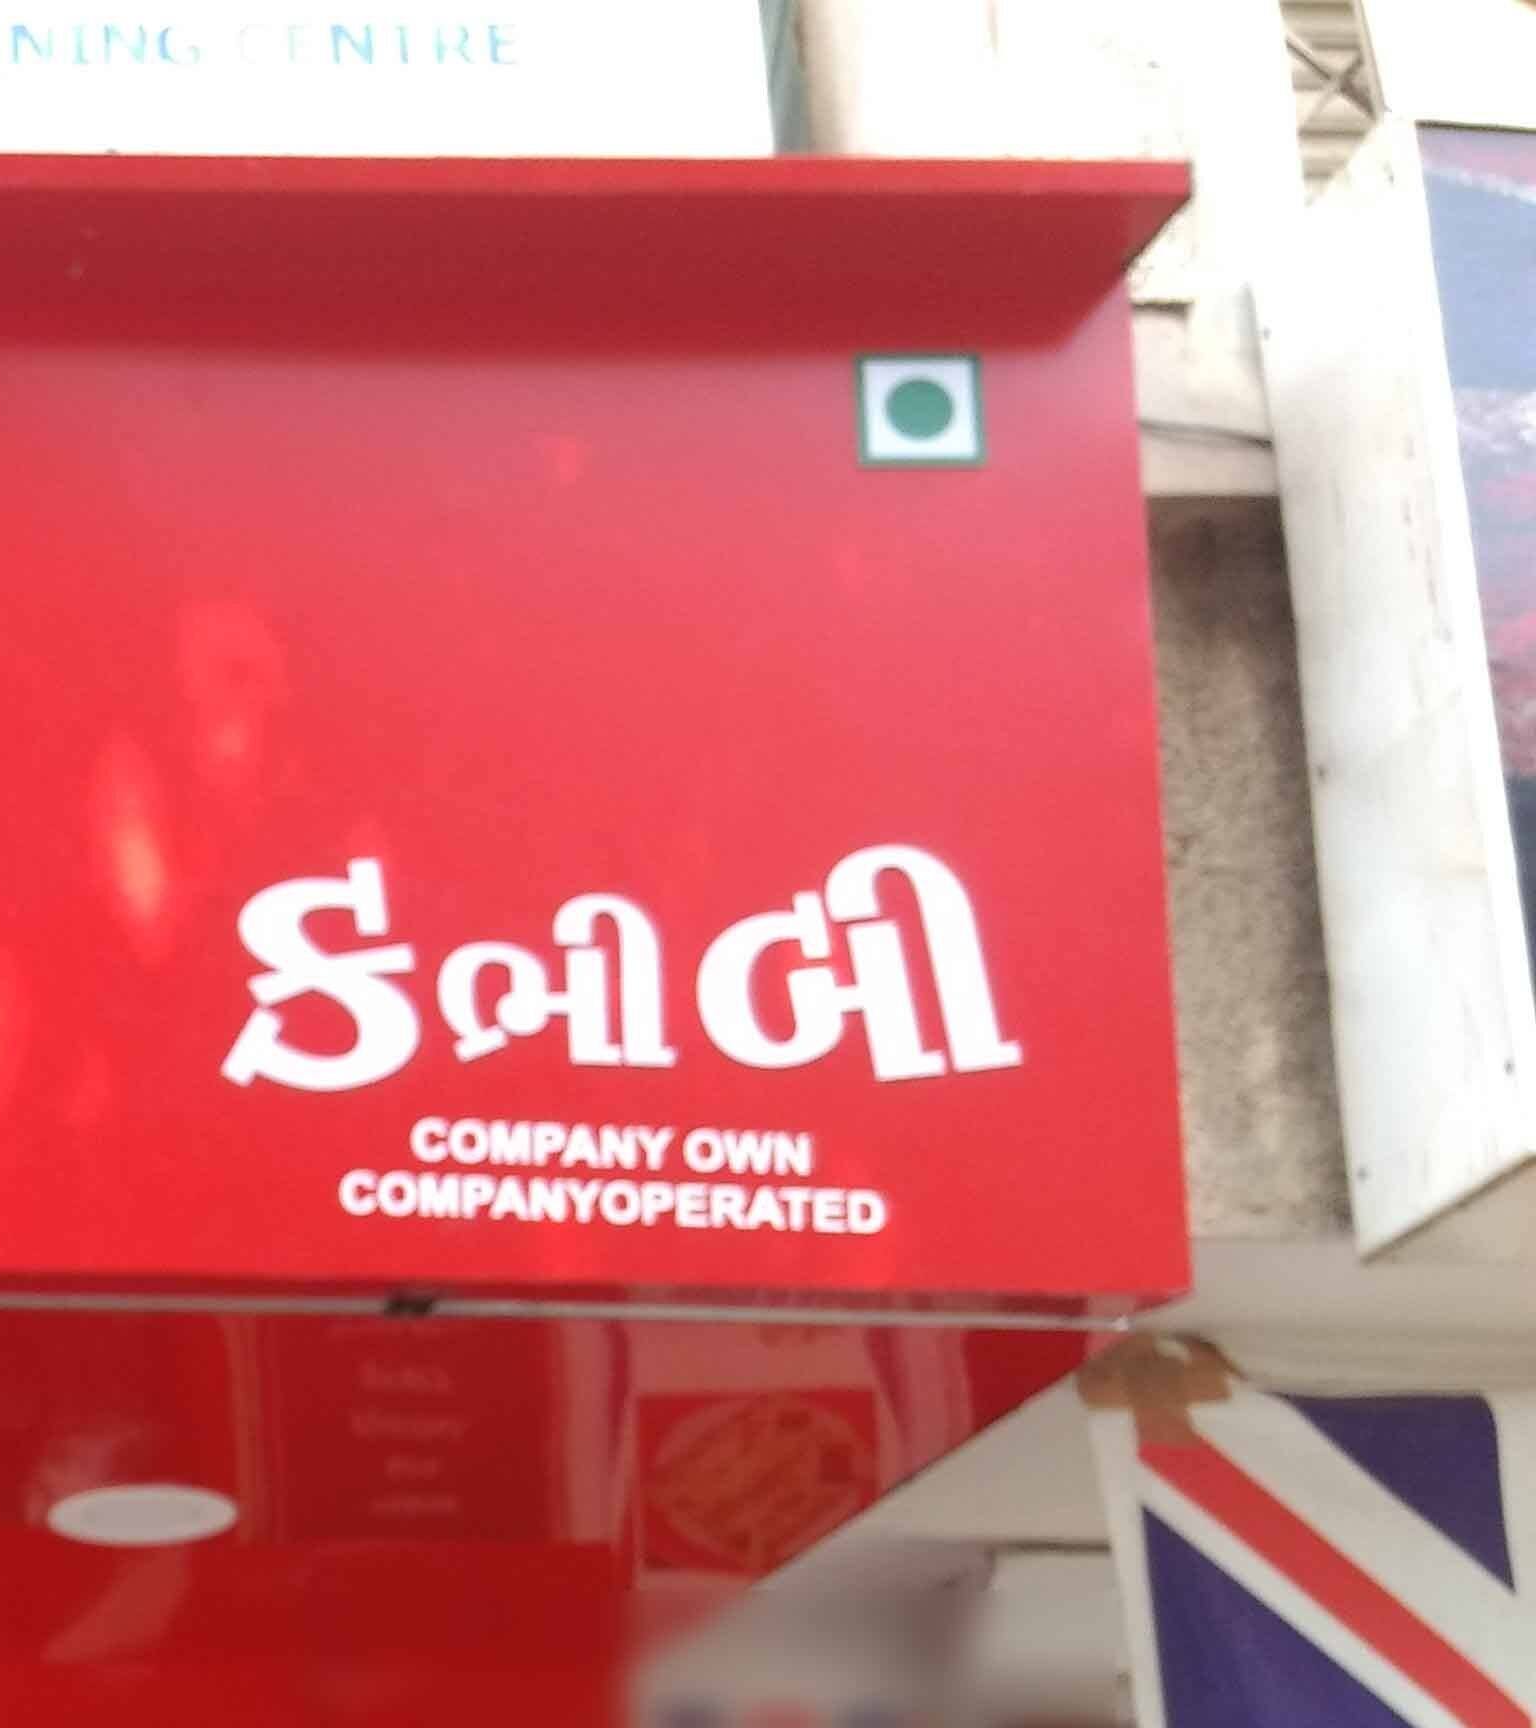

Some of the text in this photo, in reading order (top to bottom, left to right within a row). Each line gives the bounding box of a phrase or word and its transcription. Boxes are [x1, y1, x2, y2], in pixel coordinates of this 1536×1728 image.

[409, 1116, 814, 1176] COMPANY OWN
[338, 1169, 888, 1236] COMPANYOPERATED
